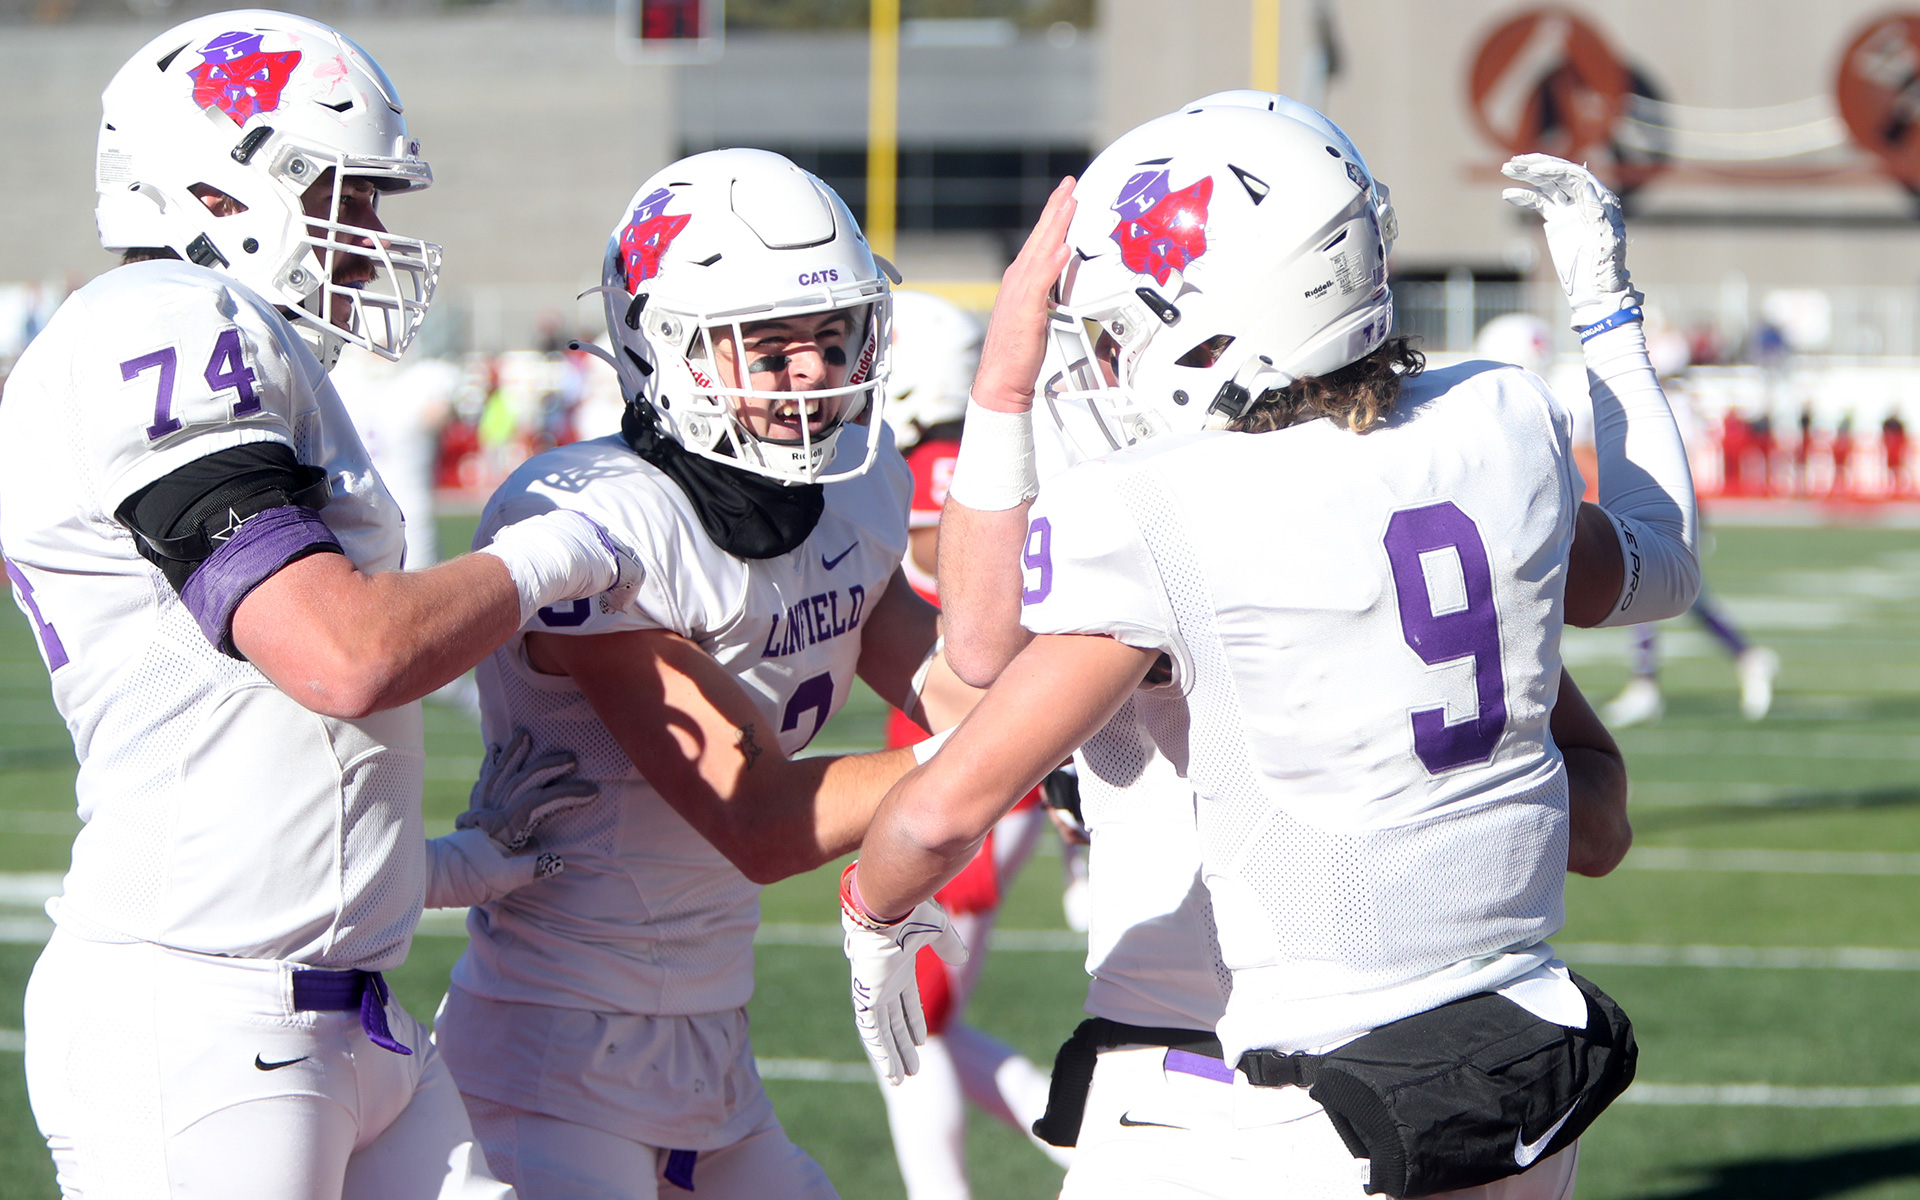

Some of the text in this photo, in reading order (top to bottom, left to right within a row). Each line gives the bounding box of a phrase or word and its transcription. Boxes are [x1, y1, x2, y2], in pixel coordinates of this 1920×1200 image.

[223, 46, 243, 61] L
[1134, 194, 1156, 213] L
[640, 206, 652, 222] L
[798, 268, 839, 286] CATS
[1305, 280, 1333, 298] Riddell
[119, 328, 262, 441] 74
[1023, 516, 1053, 606] 9
[1620, 551, 1640, 611] PRO
[1383, 501, 1507, 775] 9
